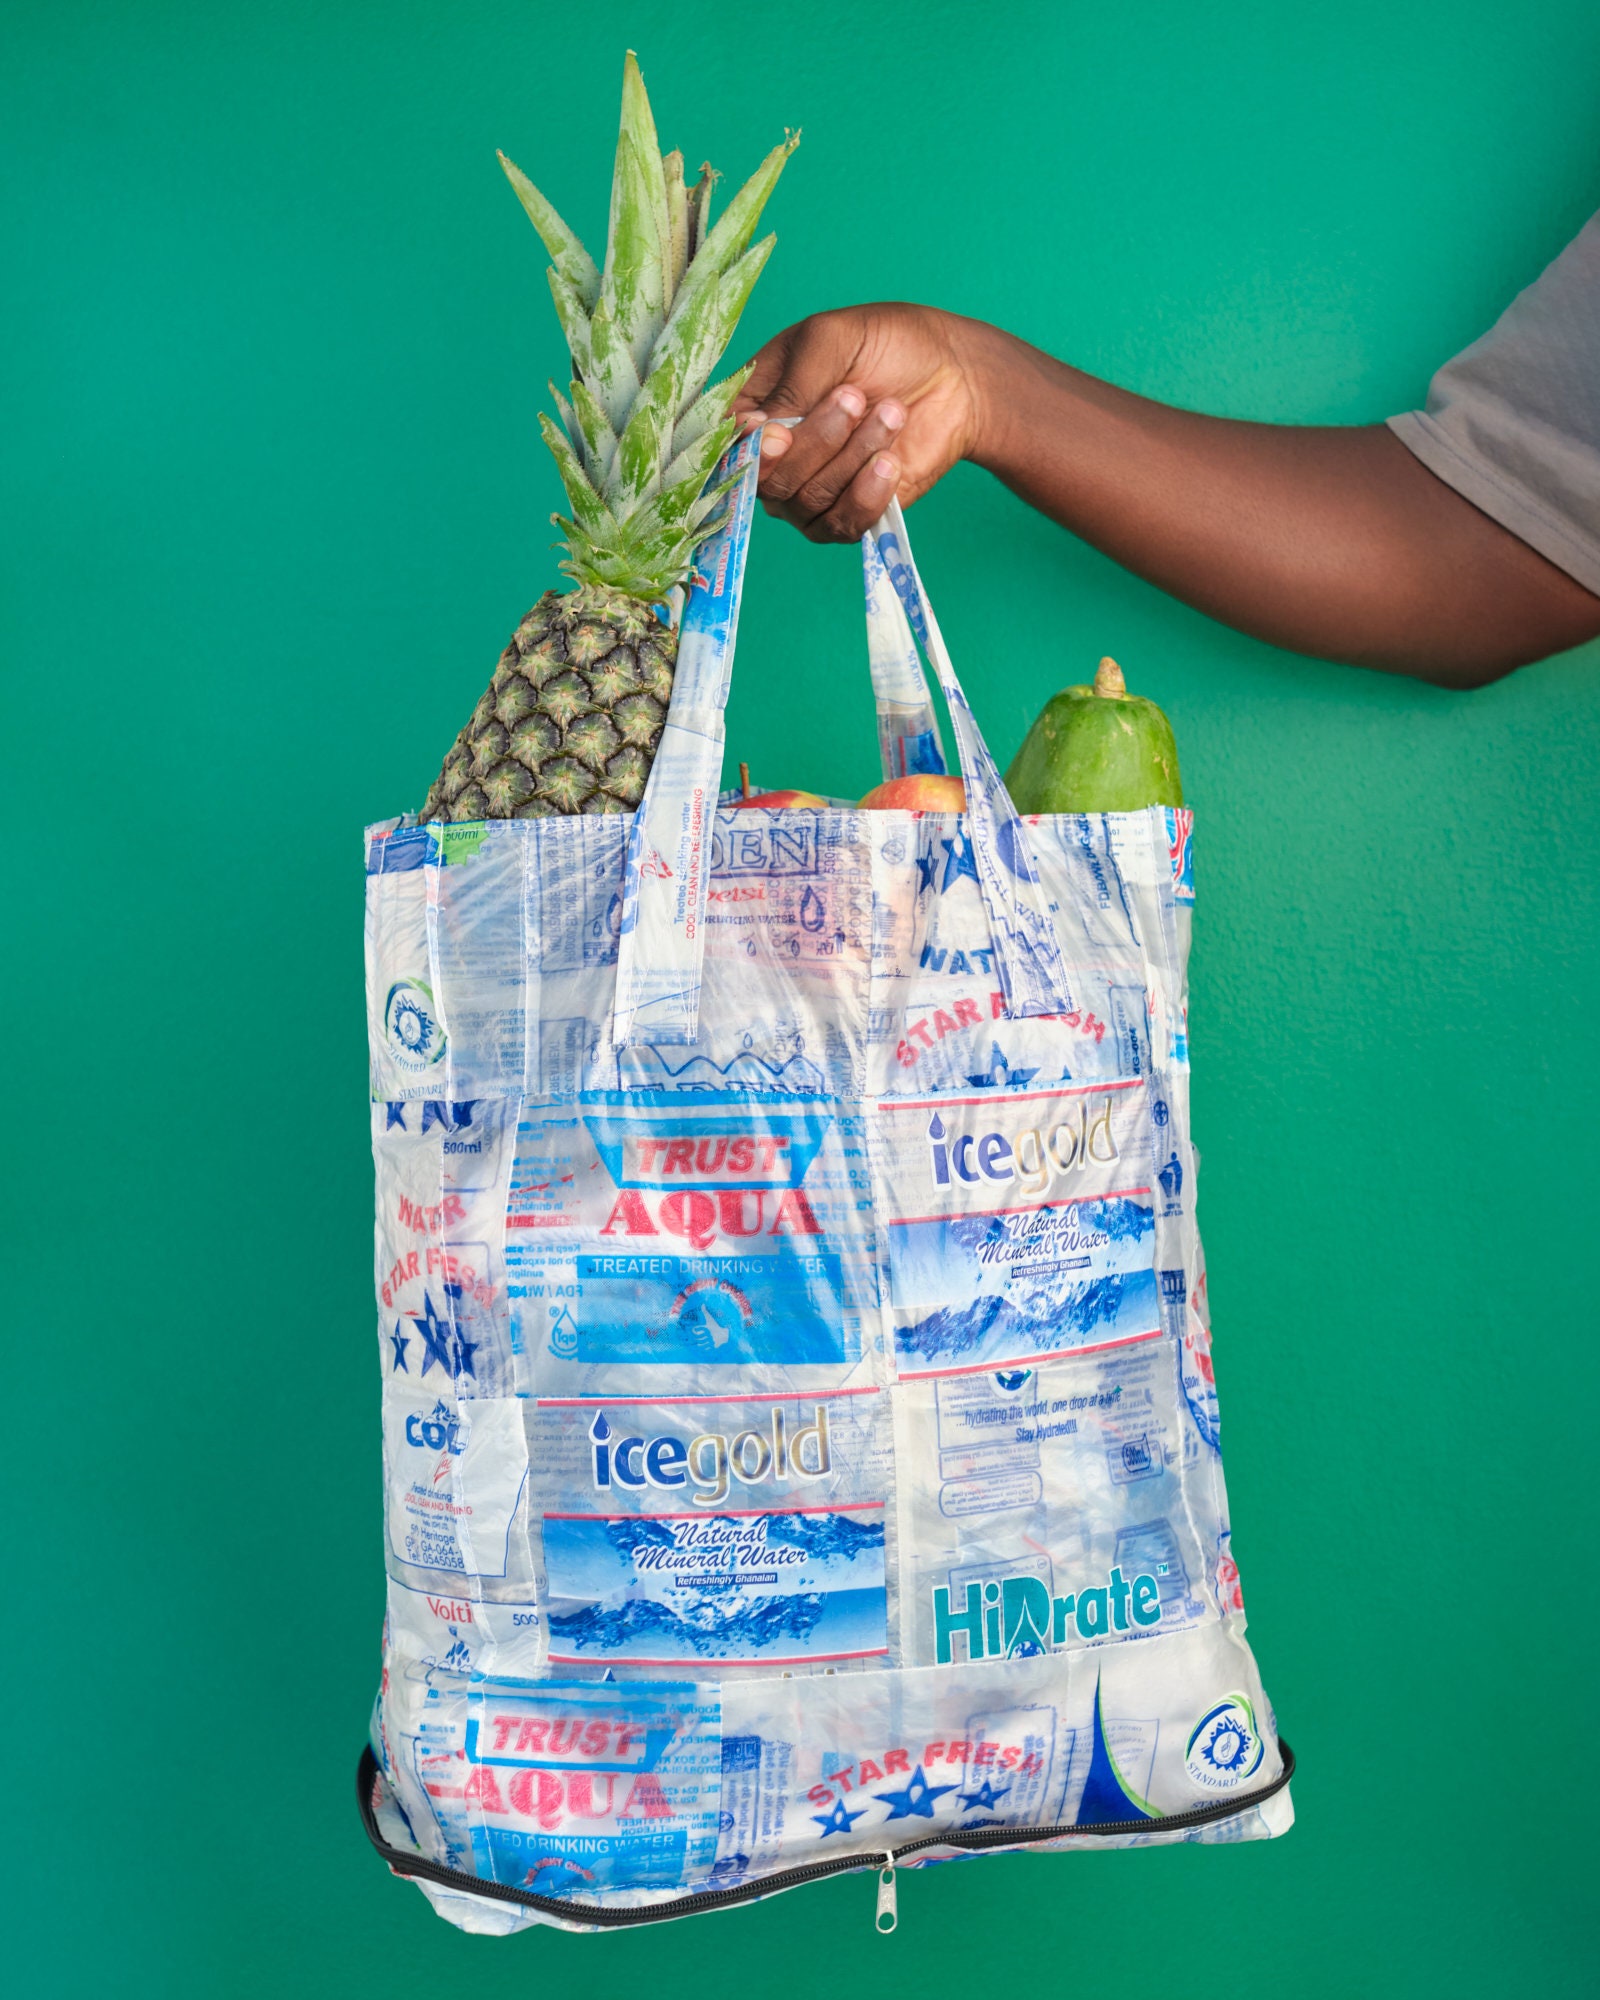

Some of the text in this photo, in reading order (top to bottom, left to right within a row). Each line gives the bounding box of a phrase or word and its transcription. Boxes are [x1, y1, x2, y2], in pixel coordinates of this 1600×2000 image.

[712, 542, 731, 597] NATURAL
[735, 442, 749, 474] ATER
[674, 801, 692, 925] Treated drinking water
[687, 877, 699, 907] CLEAN
[758, 914, 797, 926] WATER
[920, 944, 994, 975] WAT
[896, 997, 985, 1067] STAR
[388, 1042, 427, 1074] STANDARD
[443, 1140, 482, 1155] 500ml
[635, 1136, 790, 1176] TRUST
[927, 1097, 1120, 1199] icegold
[399, 1194, 467, 1236] WATR
[599, 1187, 826, 1251] AQUA
[1007, 1208, 1079, 1238] Natural
[978, 1230, 1110, 1264] Mineral Water
[382, 1248, 498, 1311] STAR FESH
[592, 1258, 673, 1274] TREATED
[680, 1258, 764, 1274] DRINKING
[1012, 1261, 1059, 1277] Refreshingly
[1008, 1405, 1023, 1420] the
[1024, 1400, 1050, 1418] world,
[1051, 1401, 1068, 1413] one
[1069, 1395, 1088, 1411] drop
[1088, 1394, 1098, 1407] at
[1016, 1427, 1034, 1443] Stay
[588, 1405, 834, 1507] icegold
[421, 1527, 456, 1545] Heritage
[673, 1521, 768, 1546] Natural
[631, 1545, 808, 1572] Mineral Water
[677, 1572, 777, 1587] Refreshingly Ghanaian
[933, 1564, 1162, 1665] HiDrate
[491, 1715, 650, 1758] TRUST
[807, 1749, 913, 1808] STAR
[924, 1740, 1045, 1777] FRESH
[1187, 1762, 1239, 1788] STANDARD
[464, 1764, 677, 1831] AQUA
[526, 1835, 609, 1853] DRINKING
[614, 1833, 675, 1853] WATER
